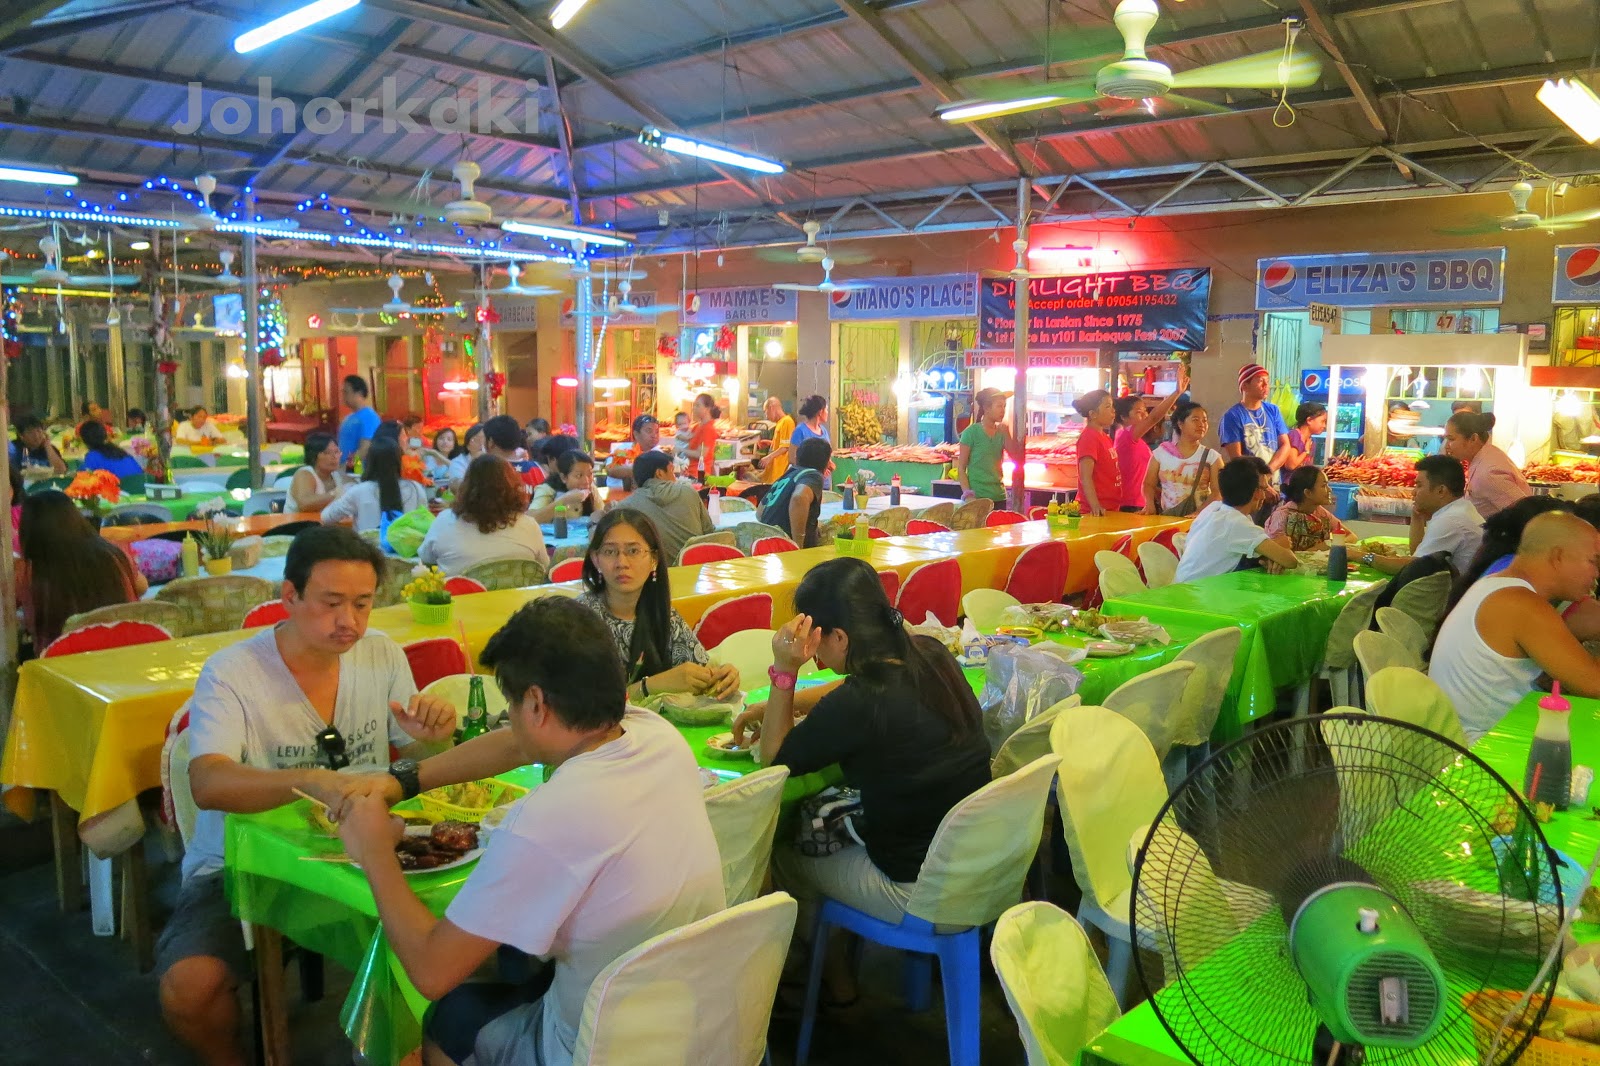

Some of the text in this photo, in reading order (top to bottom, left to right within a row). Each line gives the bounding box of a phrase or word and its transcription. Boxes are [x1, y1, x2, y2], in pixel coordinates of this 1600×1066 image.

[1129, 273, 1197, 292] BBQ
[1305, 258, 1494, 295] ELIZA'S BBQ
[709, 288, 786, 308] MAMAE'S
[855, 282, 973, 310] MANO'S PLACE
[1028, 298, 1064, 311] Accept
[1066, 297, 1094, 308] order
[1106, 294, 1177, 307] 09054195432
[995, 317, 1032, 328] Pionr
[1083, 314, 1114, 328] Since
[1116, 314, 1143, 327] 1975
[1436, 315, 1454, 329] 47
[1010, 331, 1038, 343] Pce
[972, 356, 1089, 366] HOT POERO SOUP
[1325, 377, 1361, 389] peps
[277, 745, 305, 758] LEVI
[364, 719, 377, 734] CO
